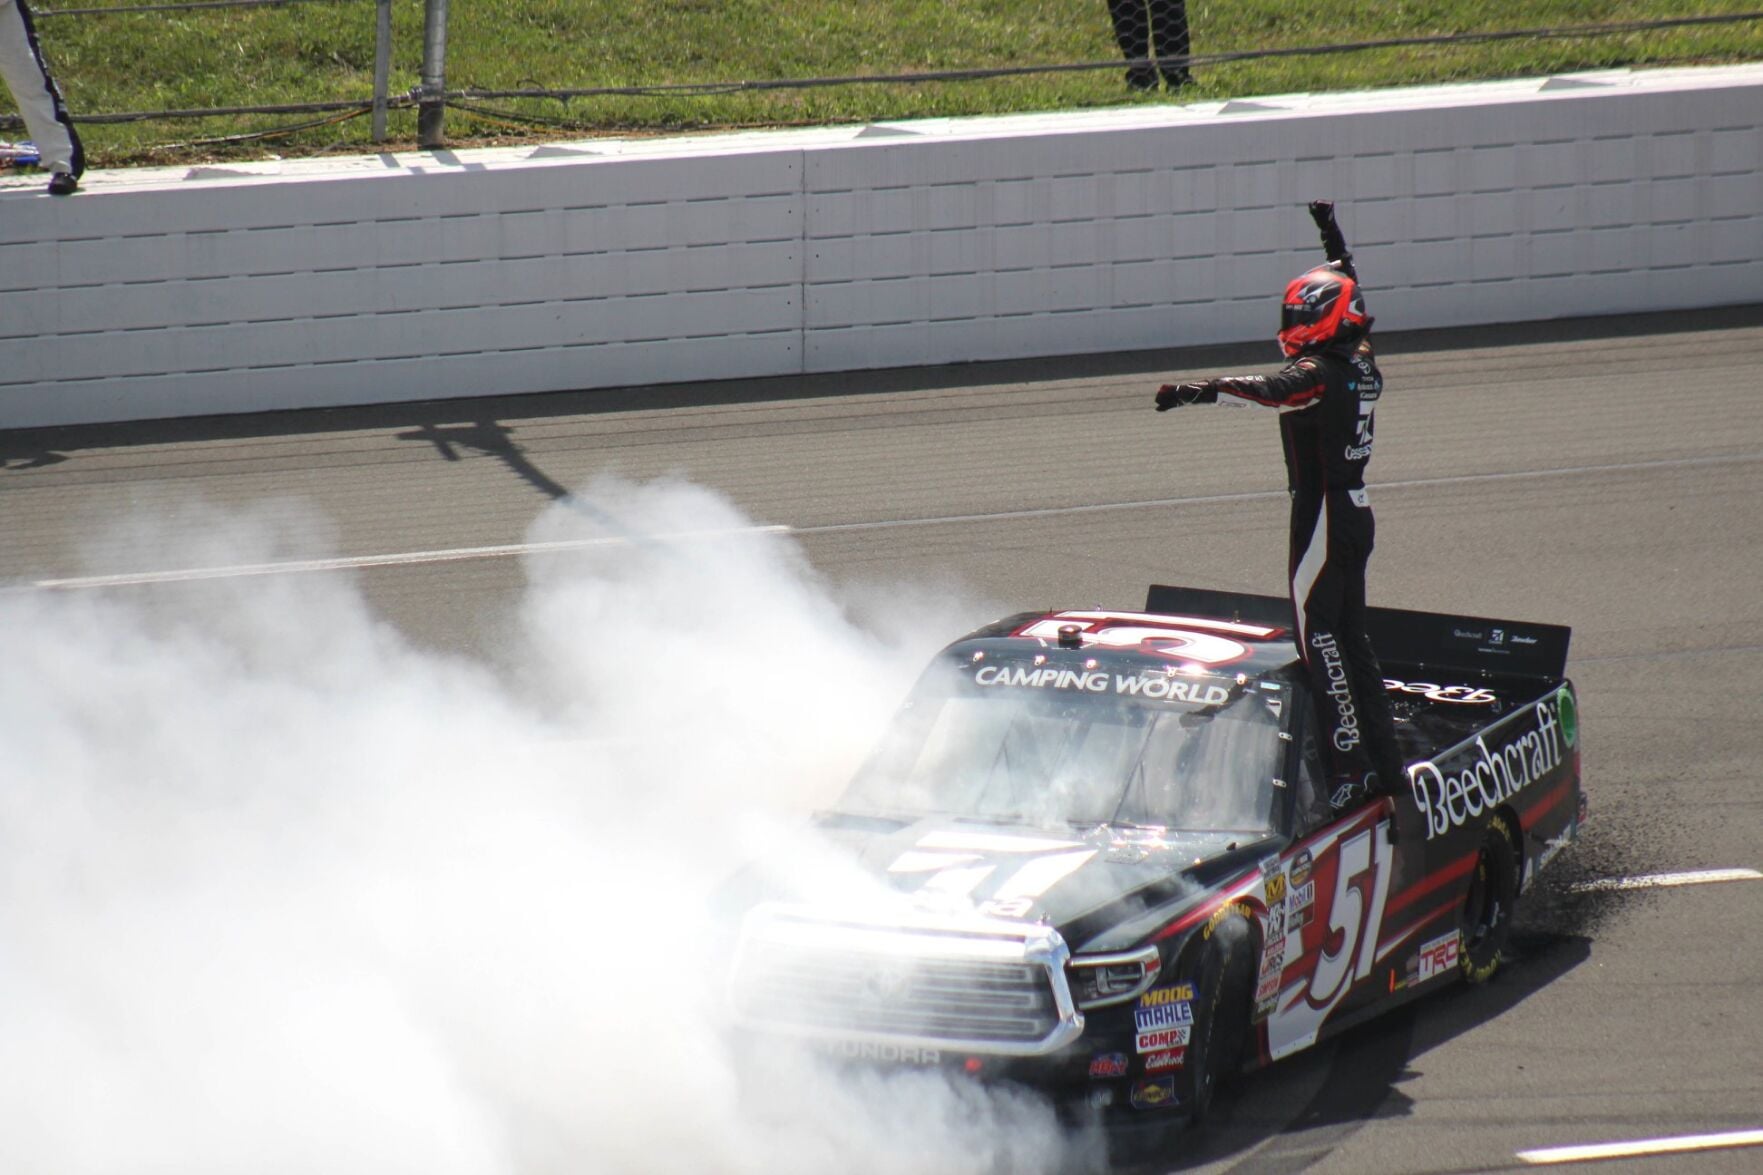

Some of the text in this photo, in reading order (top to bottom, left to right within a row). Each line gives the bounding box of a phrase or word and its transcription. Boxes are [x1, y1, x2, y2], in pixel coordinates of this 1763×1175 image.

[974, 666, 1230, 706] CAMPING WORLD
[1312, 632, 1360, 752] Beechcraft
[1407, 702, 1562, 841] Beechcraft
[1309, 818, 1395, 1001] 51
[1140, 983, 1194, 1008] MOOG
[1136, 1003, 1192, 1028] MAHLE
[828, 1040, 941, 1064] TUNDRA
[1138, 1030, 1178, 1049] COMP
[1145, 1050, 1185, 1069] Edelbrock
